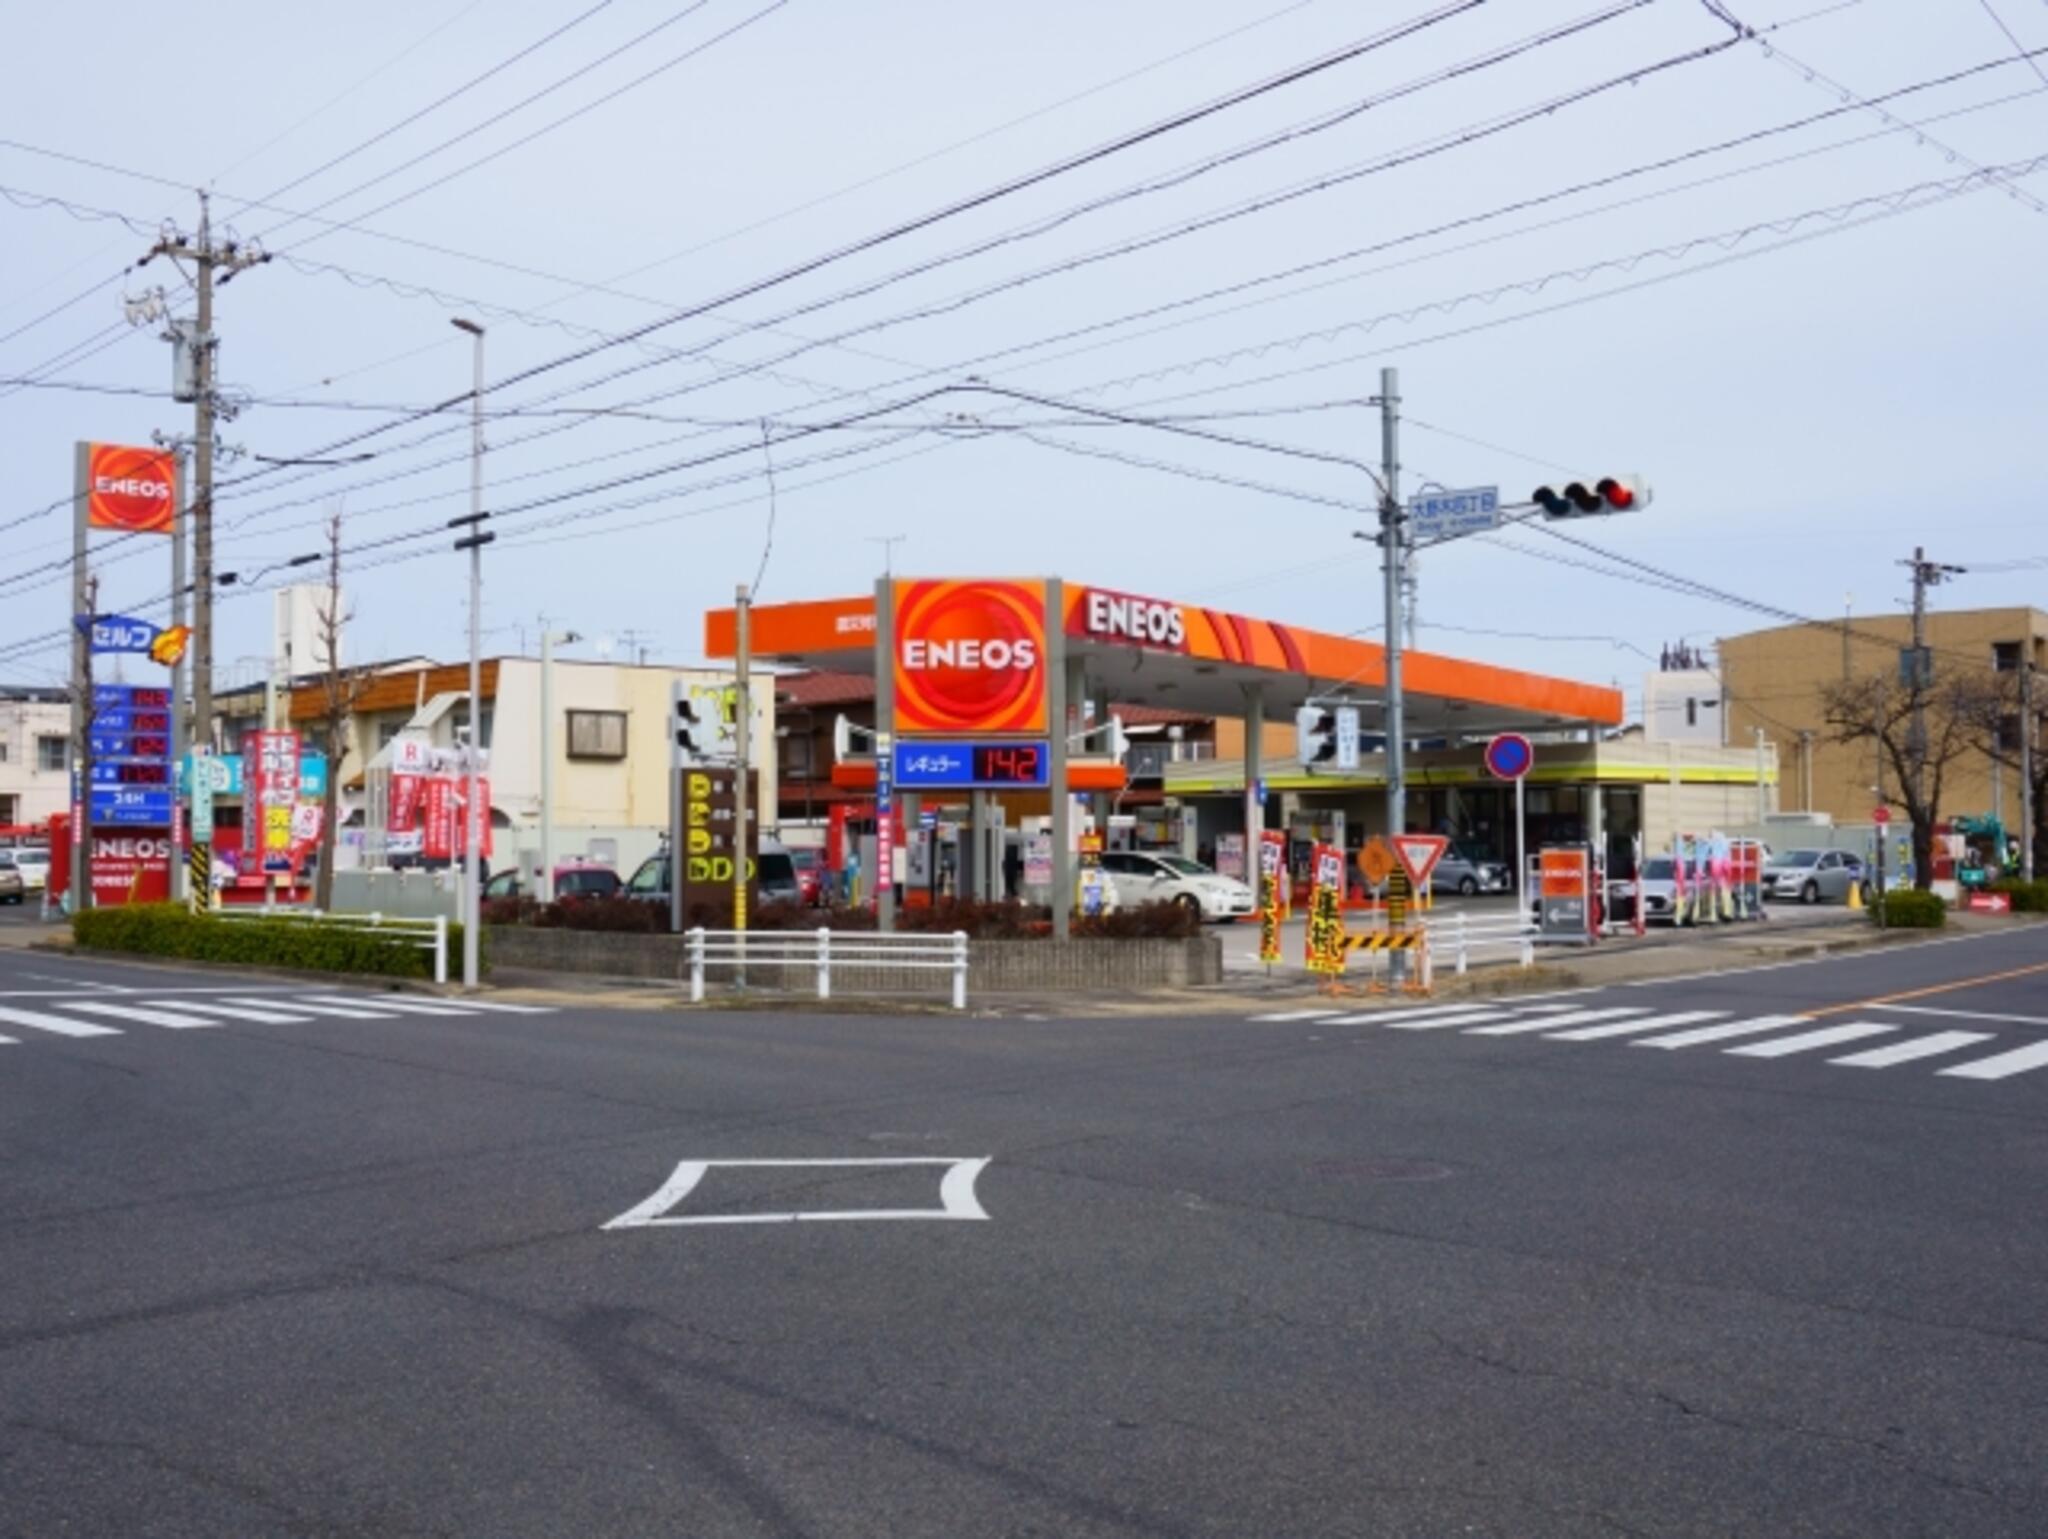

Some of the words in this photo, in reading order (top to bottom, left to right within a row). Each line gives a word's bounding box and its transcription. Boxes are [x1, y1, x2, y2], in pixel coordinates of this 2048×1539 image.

[95, 476, 170, 500] ENEOS
[1089, 592, 1184, 645] ENEOS
[93, 624, 151, 648] セルフ
[903, 639, 1035, 670] ENEOS
[905, 755, 961, 773] レギュラー
[987, 748, 1038, 782] 142
